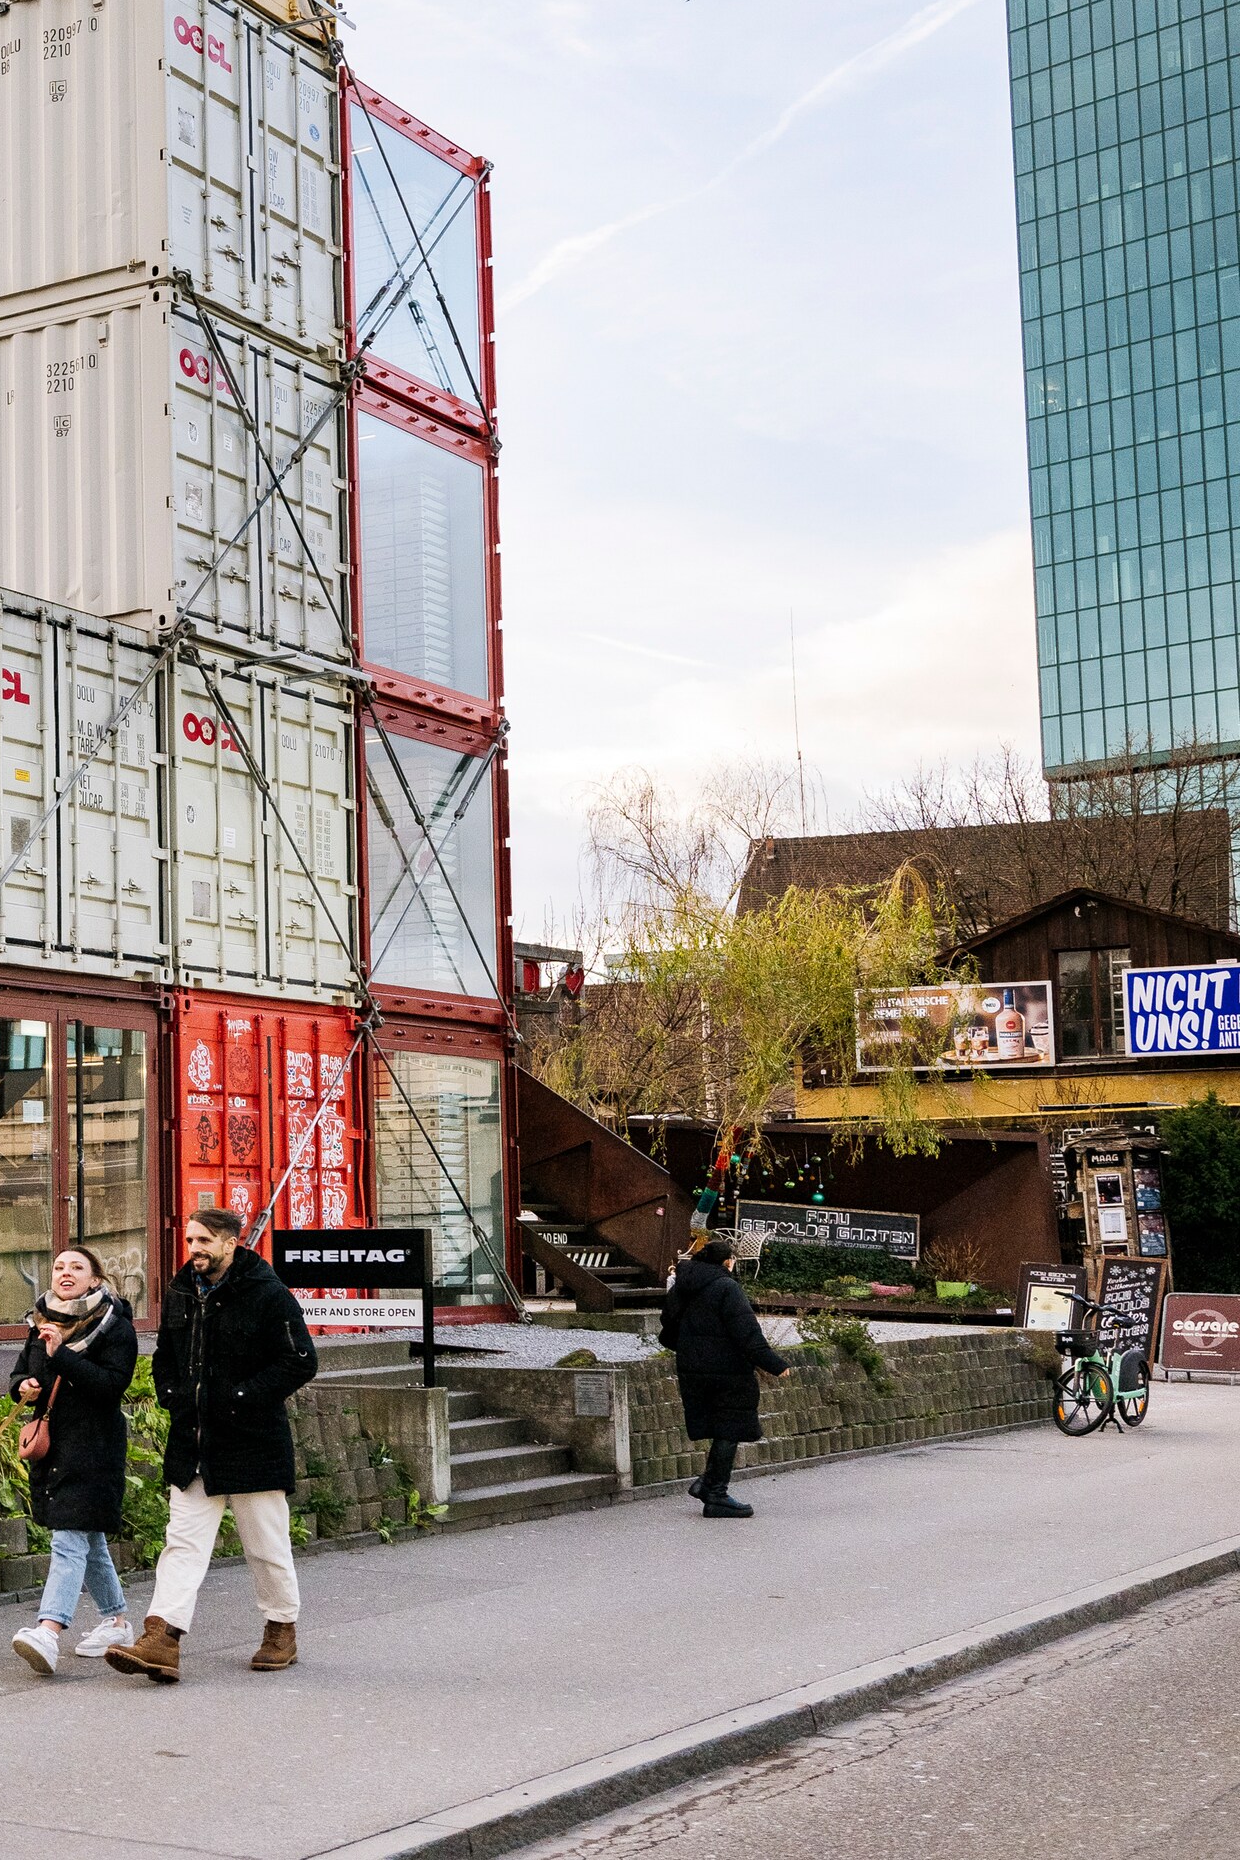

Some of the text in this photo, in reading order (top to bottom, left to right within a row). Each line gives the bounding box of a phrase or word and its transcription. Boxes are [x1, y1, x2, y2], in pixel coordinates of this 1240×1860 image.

[43, 43, 71, 60] 2210
[51, 94, 65, 102] 87
[298, 81, 320, 104] 20997
[268, 147, 279, 165] GW
[47, 377, 75, 394] 2210
[55, 430, 70, 438] 87
[1132, 971, 1231, 1013] NICHT
[1135, 1008, 1214, 1051] UNS!
[1091, 1154, 1119, 1163] MAAG
[806, 1210, 850, 1225] FRAU
[553, 1233, 568, 1244] END
[836, 1227, 915, 1244] GARTEN
[300, 1307, 416, 1317] OWER AND STORE OPEN
